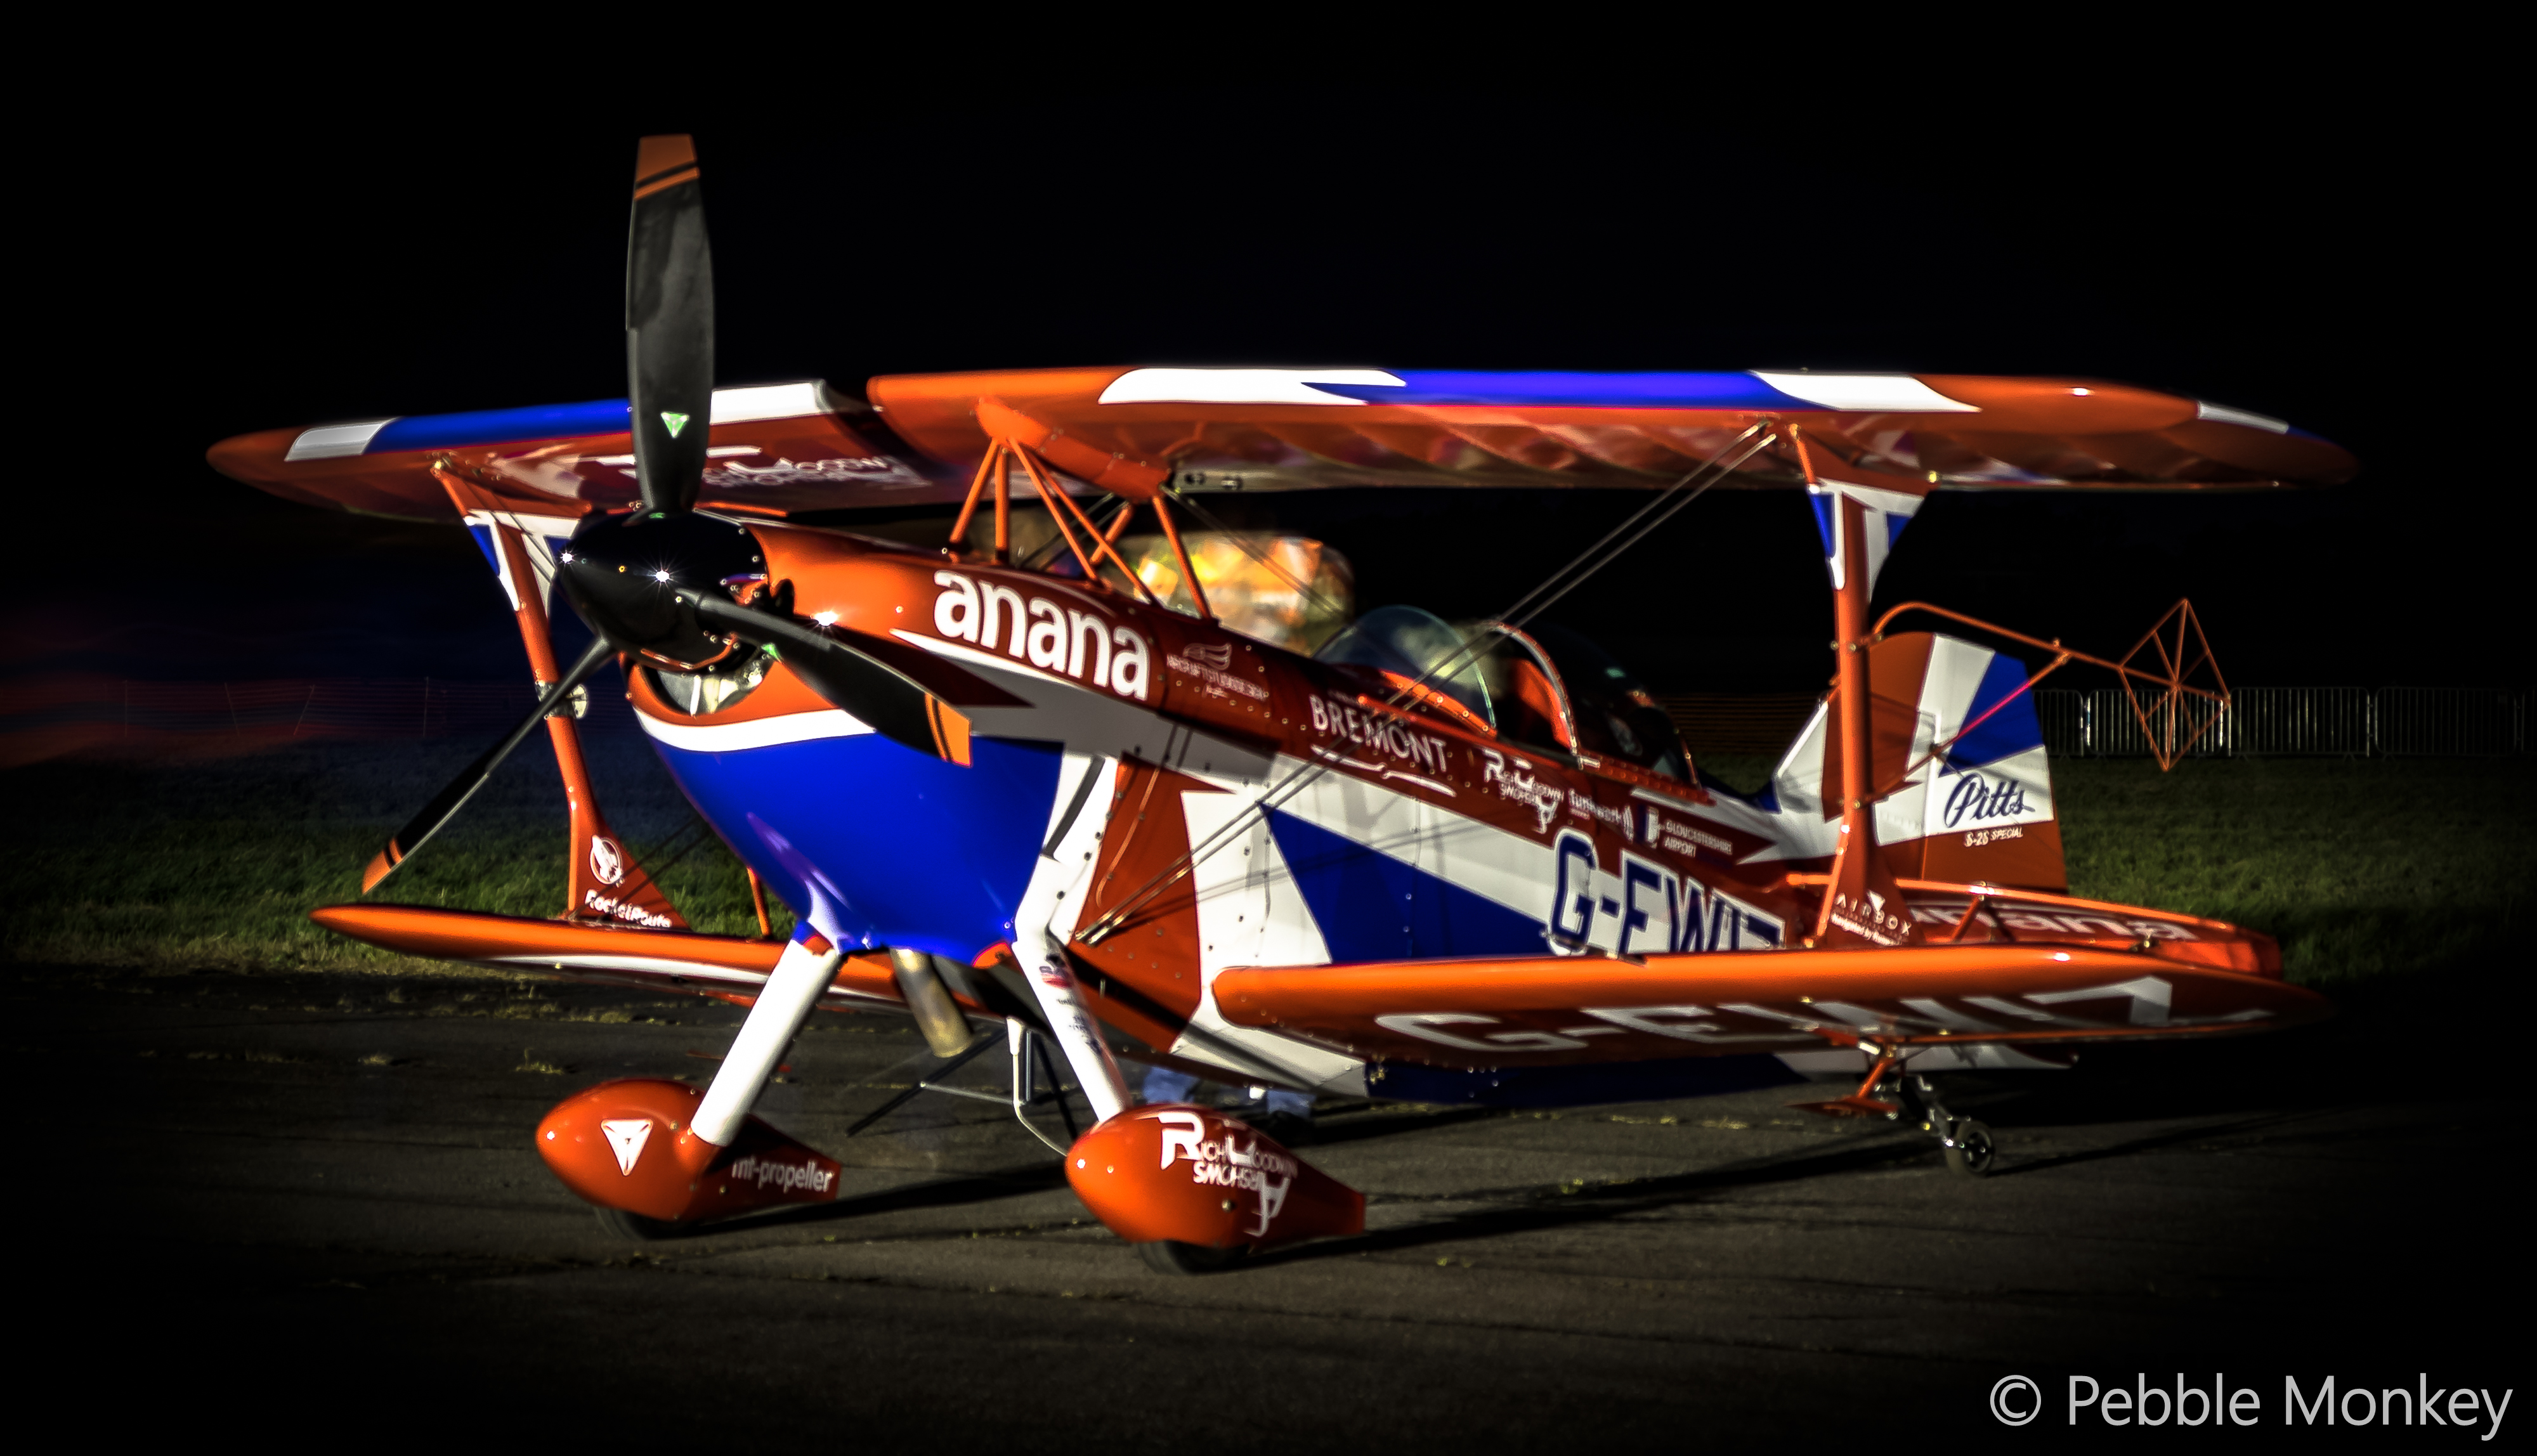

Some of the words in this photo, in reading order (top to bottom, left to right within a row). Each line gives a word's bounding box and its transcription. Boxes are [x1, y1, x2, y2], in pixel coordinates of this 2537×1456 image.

[934, 570, 1151, 701] anana
[1309, 694, 1447, 772] BREMONT
[1944, 772, 2036, 828] Pitts
[1662, 836, 1697, 858] AIRPORT
[1990, 826, 2024, 842] SPECIAL
[1835, 892, 1912, 937] AIRBOX
[731, 1153, 836, 1193] mt-propeller
